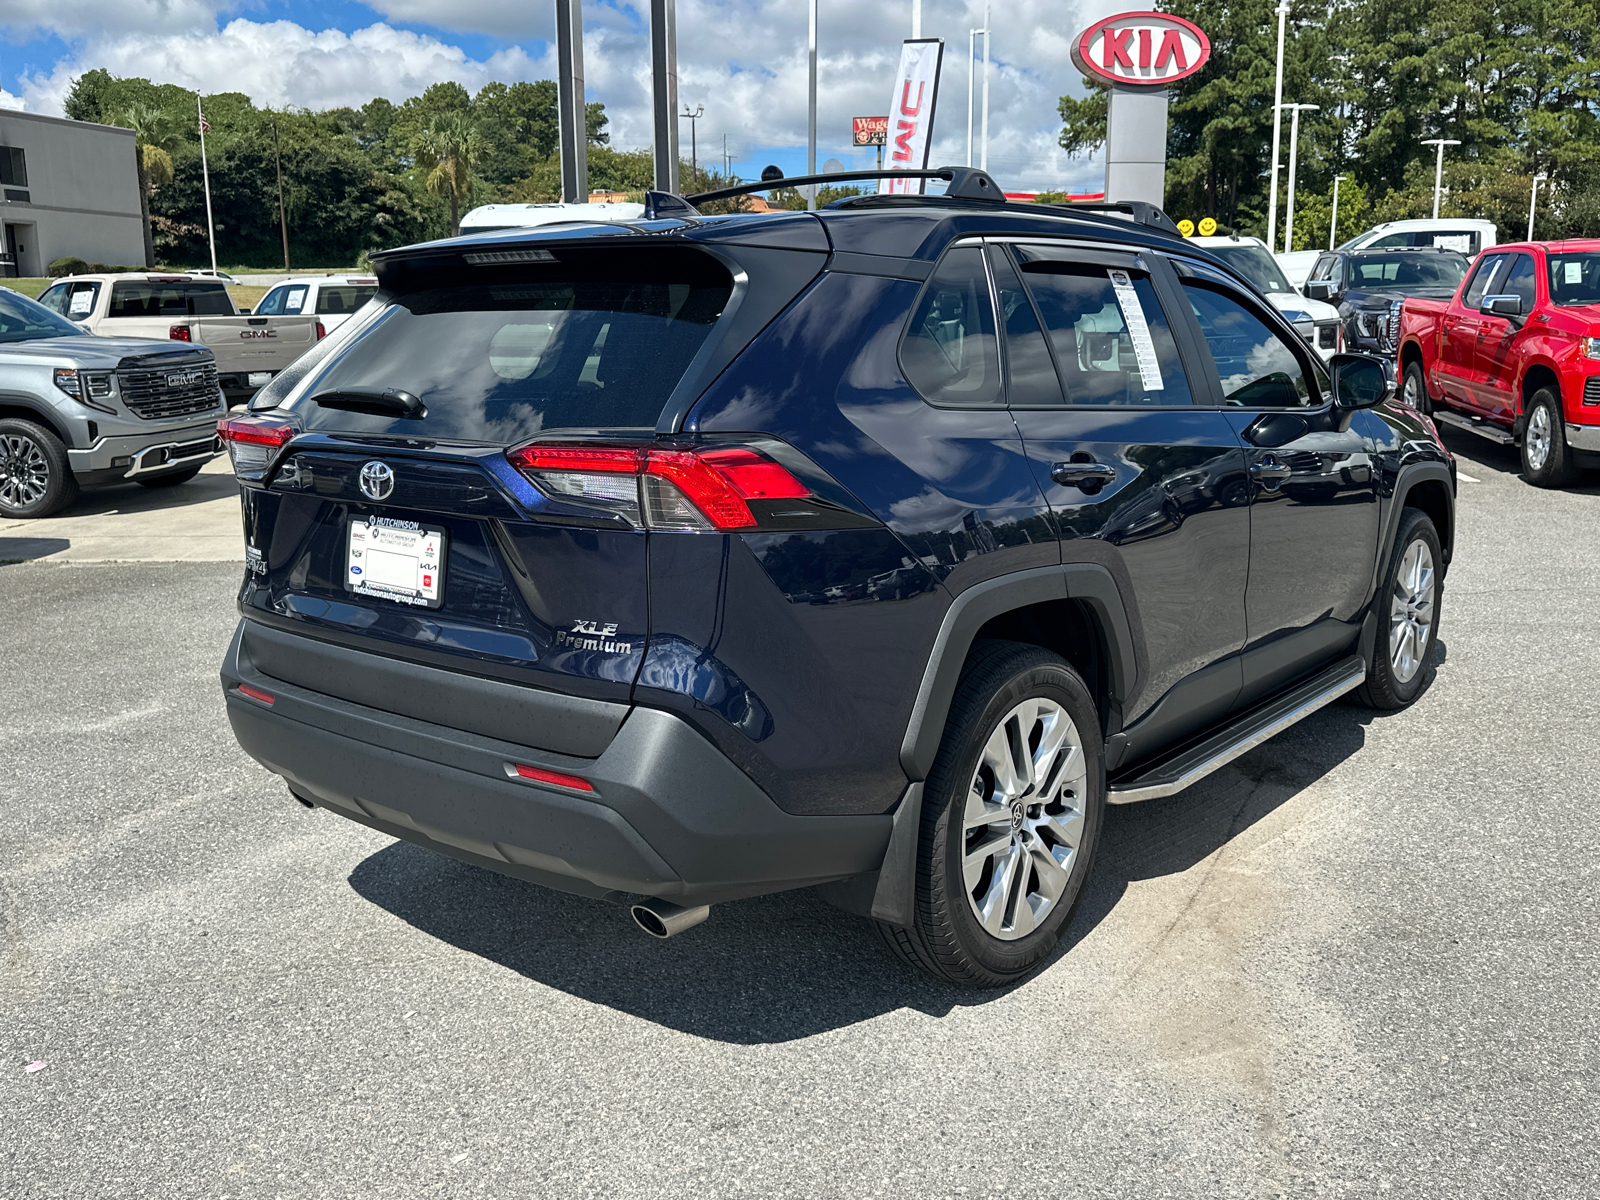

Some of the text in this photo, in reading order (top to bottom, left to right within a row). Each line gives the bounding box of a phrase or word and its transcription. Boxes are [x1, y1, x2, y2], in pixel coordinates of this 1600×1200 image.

[1102, 28, 1187, 69] KIA
[240, 330, 277, 339] GMC
[167, 372, 203, 387] GMC
[376, 517, 419, 530] HUTCHINSON
[353, 584, 428, 606] Hutchinsonautogroup.com
[571, 619, 618, 637] XLE
[556, 630, 632, 655] Premium
